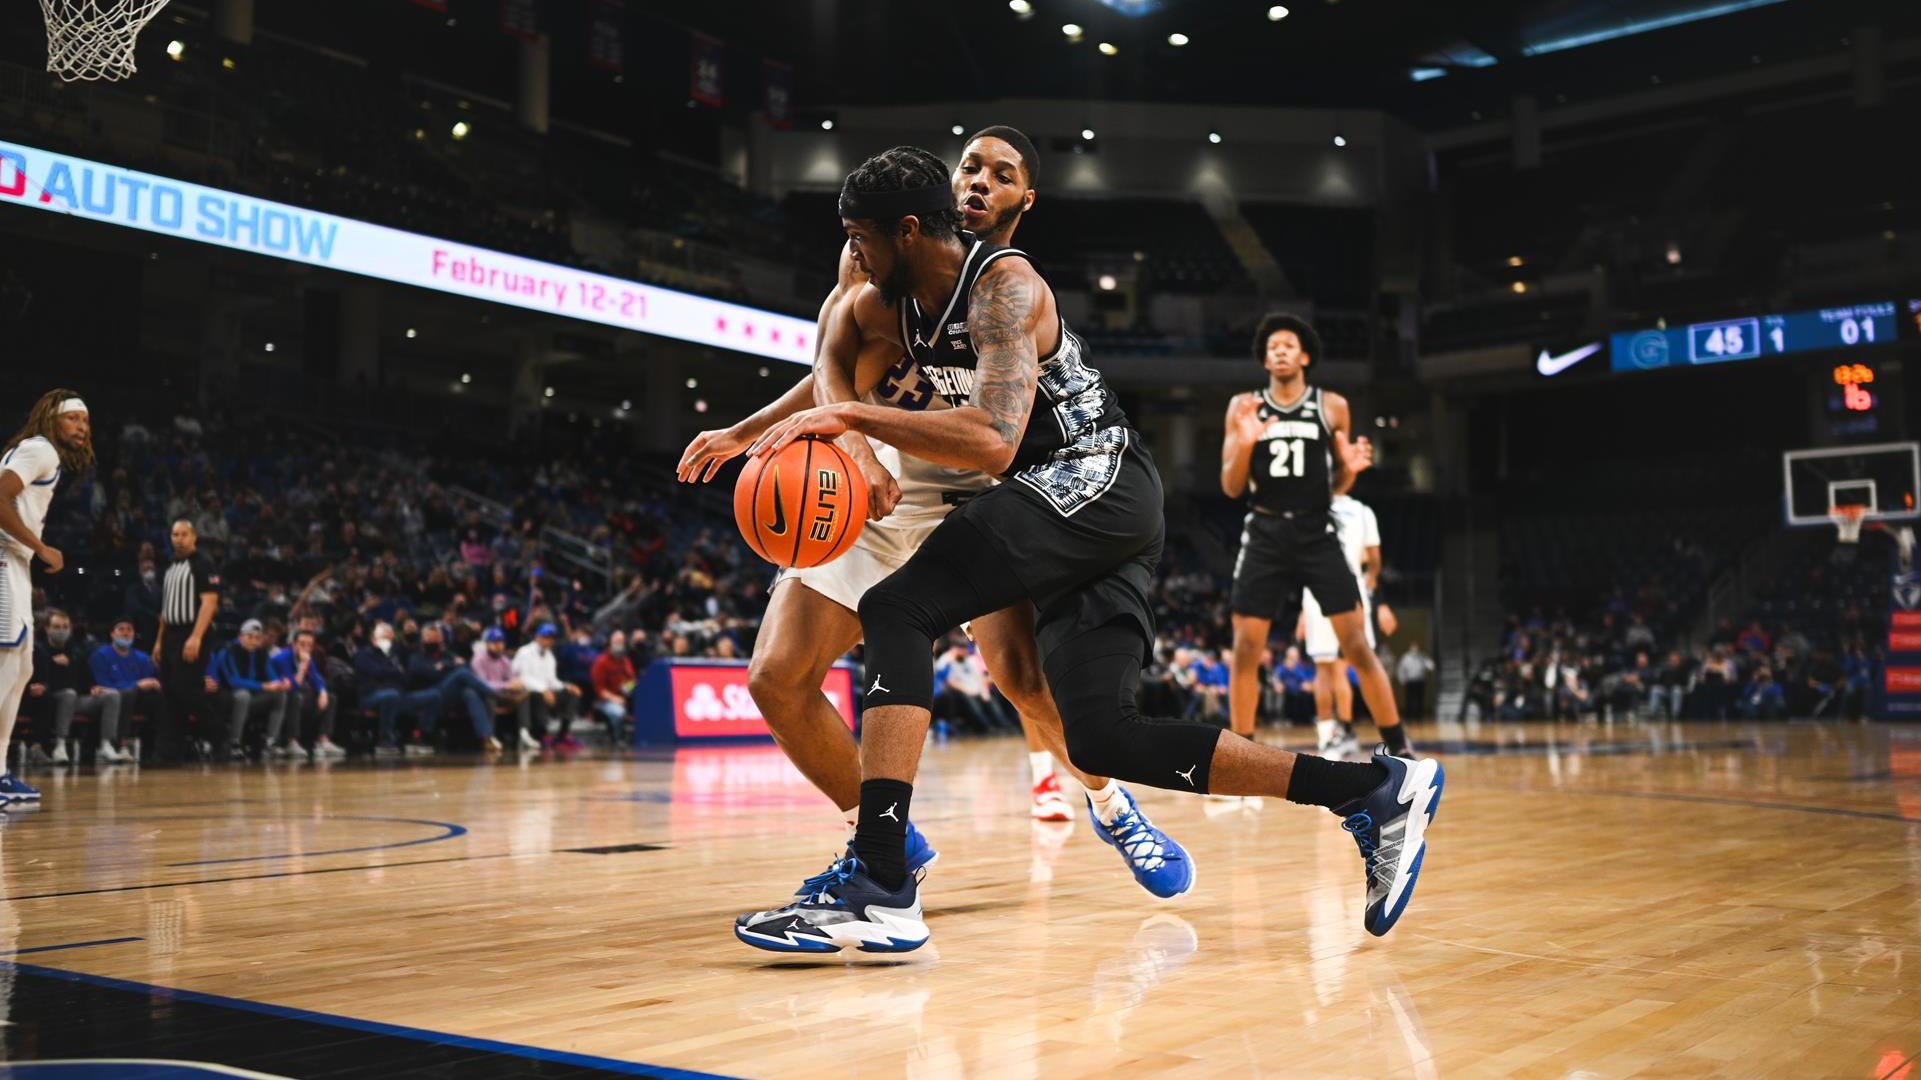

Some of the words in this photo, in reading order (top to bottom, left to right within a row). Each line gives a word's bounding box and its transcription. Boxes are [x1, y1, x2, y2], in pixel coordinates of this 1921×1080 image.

[39, 161, 184, 230] AUTO
[197, 195, 338, 261] SHOW
[432, 250, 567, 306] February
[580, 283, 648, 318] 12-21
[1705, 325, 1744, 355] 45
[1769, 327, 1784, 351] 1
[1841, 316, 1875, 345] 01
[877, 355, 933, 411] 23
[1269, 439, 1305, 477] 21
[809, 469, 837, 541] ELITE
